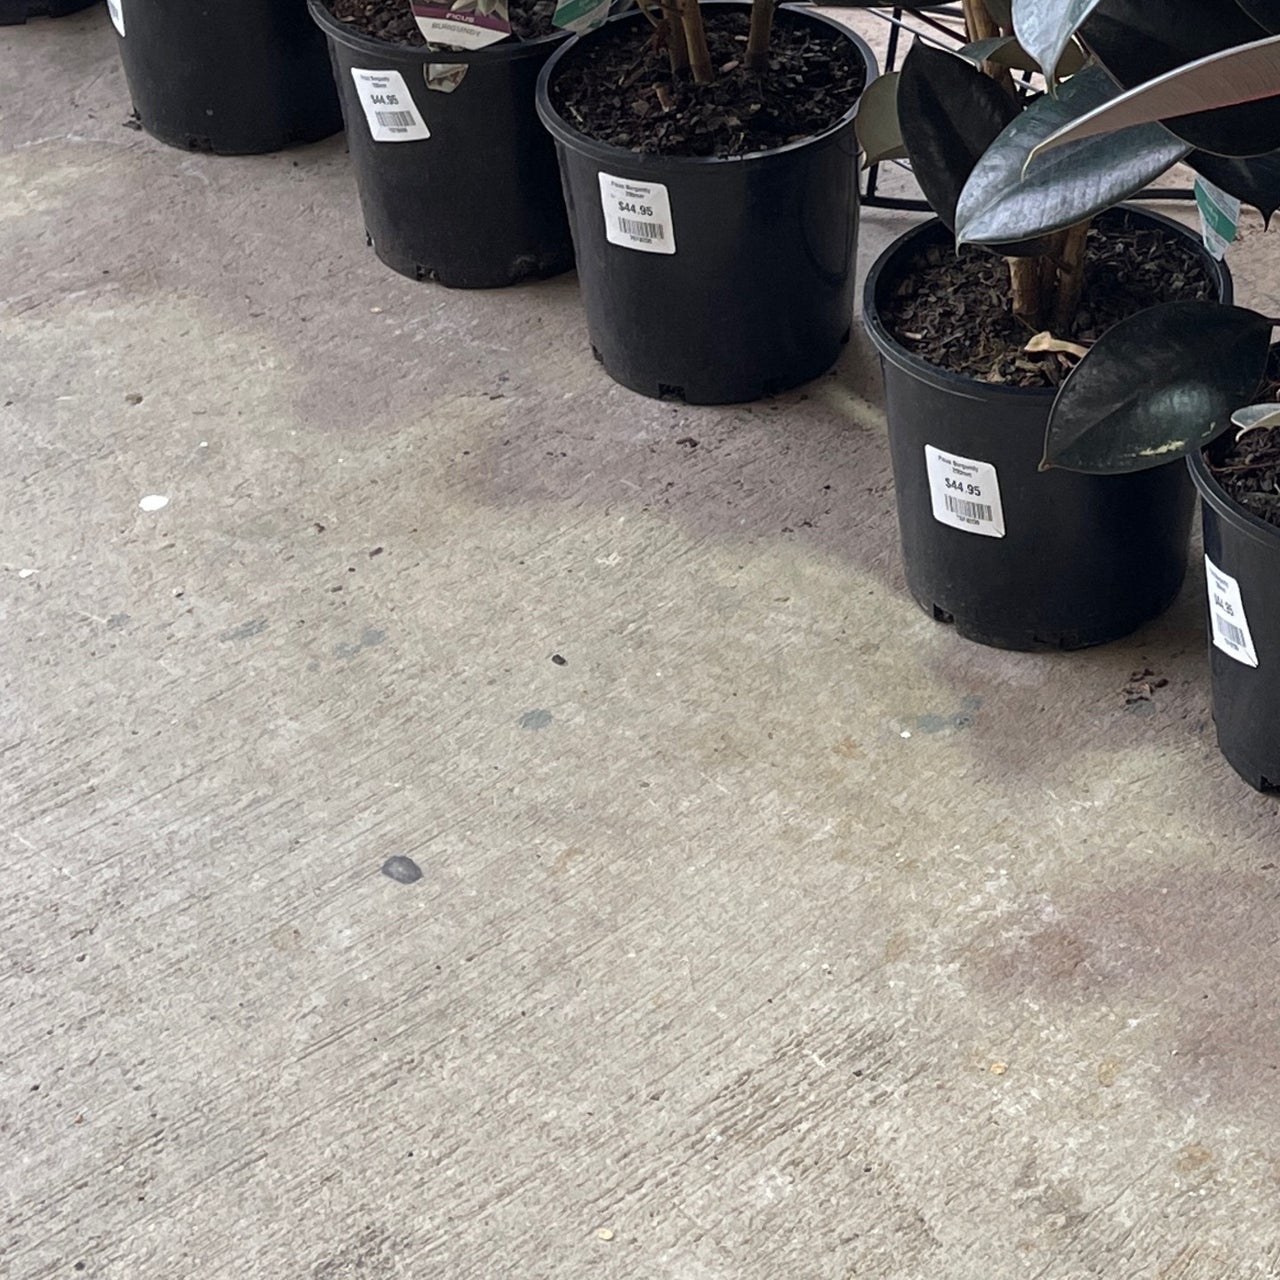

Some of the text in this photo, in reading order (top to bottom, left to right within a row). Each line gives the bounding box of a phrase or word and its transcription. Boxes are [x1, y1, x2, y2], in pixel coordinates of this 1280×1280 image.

[446, 12, 475, 23] FICUS
[618, 200, 653, 216] $44.95
[945, 478, 981, 497] $44.95
